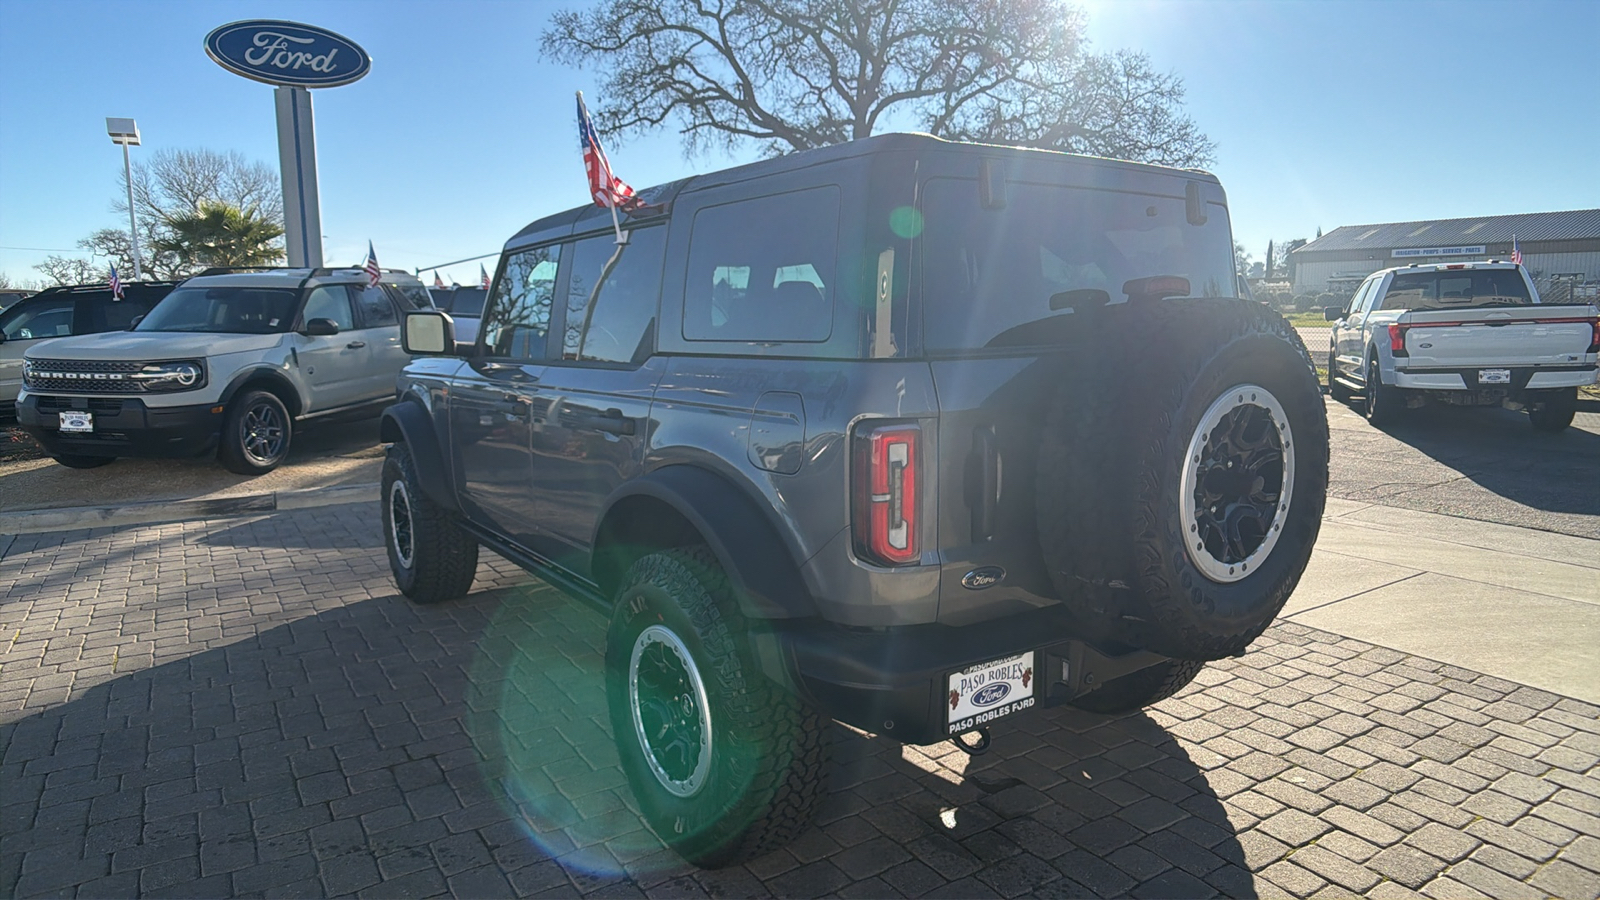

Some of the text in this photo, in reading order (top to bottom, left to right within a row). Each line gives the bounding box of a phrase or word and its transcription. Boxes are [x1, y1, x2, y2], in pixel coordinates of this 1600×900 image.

[245, 31, 339, 73] Ford
[40, 372, 123, 380] BRONCO
[960, 673, 985, 698] PASO
[988, 662, 1023, 681] ROBLES
[980, 685, 1004, 704] Ford
[949, 697, 1035, 734] PASO ROBLES FORD
